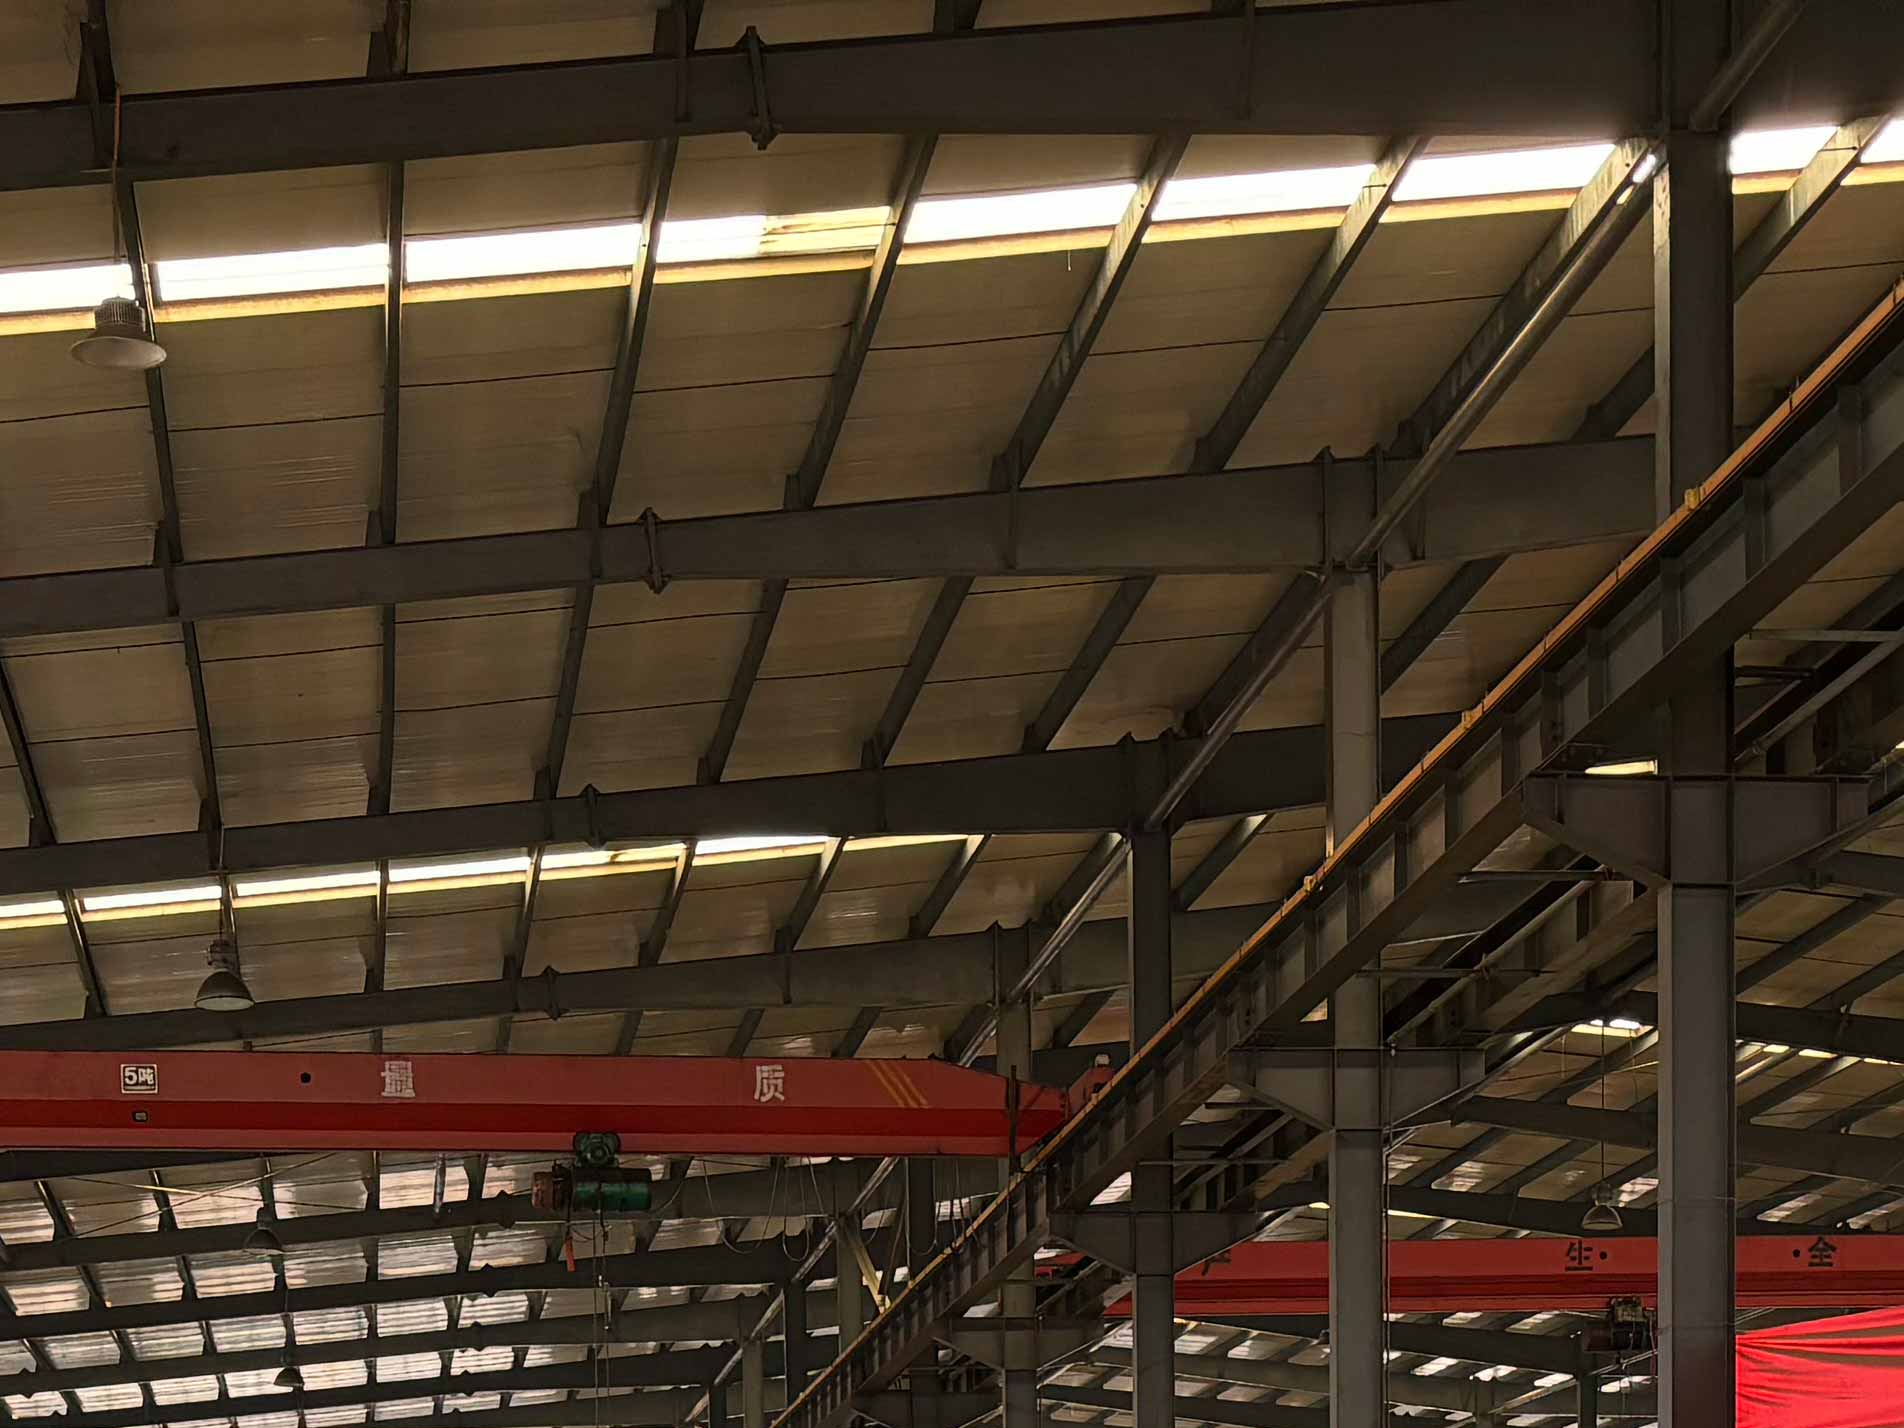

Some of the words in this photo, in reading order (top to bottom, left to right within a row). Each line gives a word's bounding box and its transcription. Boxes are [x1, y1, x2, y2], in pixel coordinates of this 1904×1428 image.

[124, 1066, 155, 1085] 5吨
[381, 1061, 416, 1097] 量
[754, 1065, 785, 1102] 质
[1564, 1239, 1594, 1271] 生
[1807, 1236, 1838, 1267] 全
